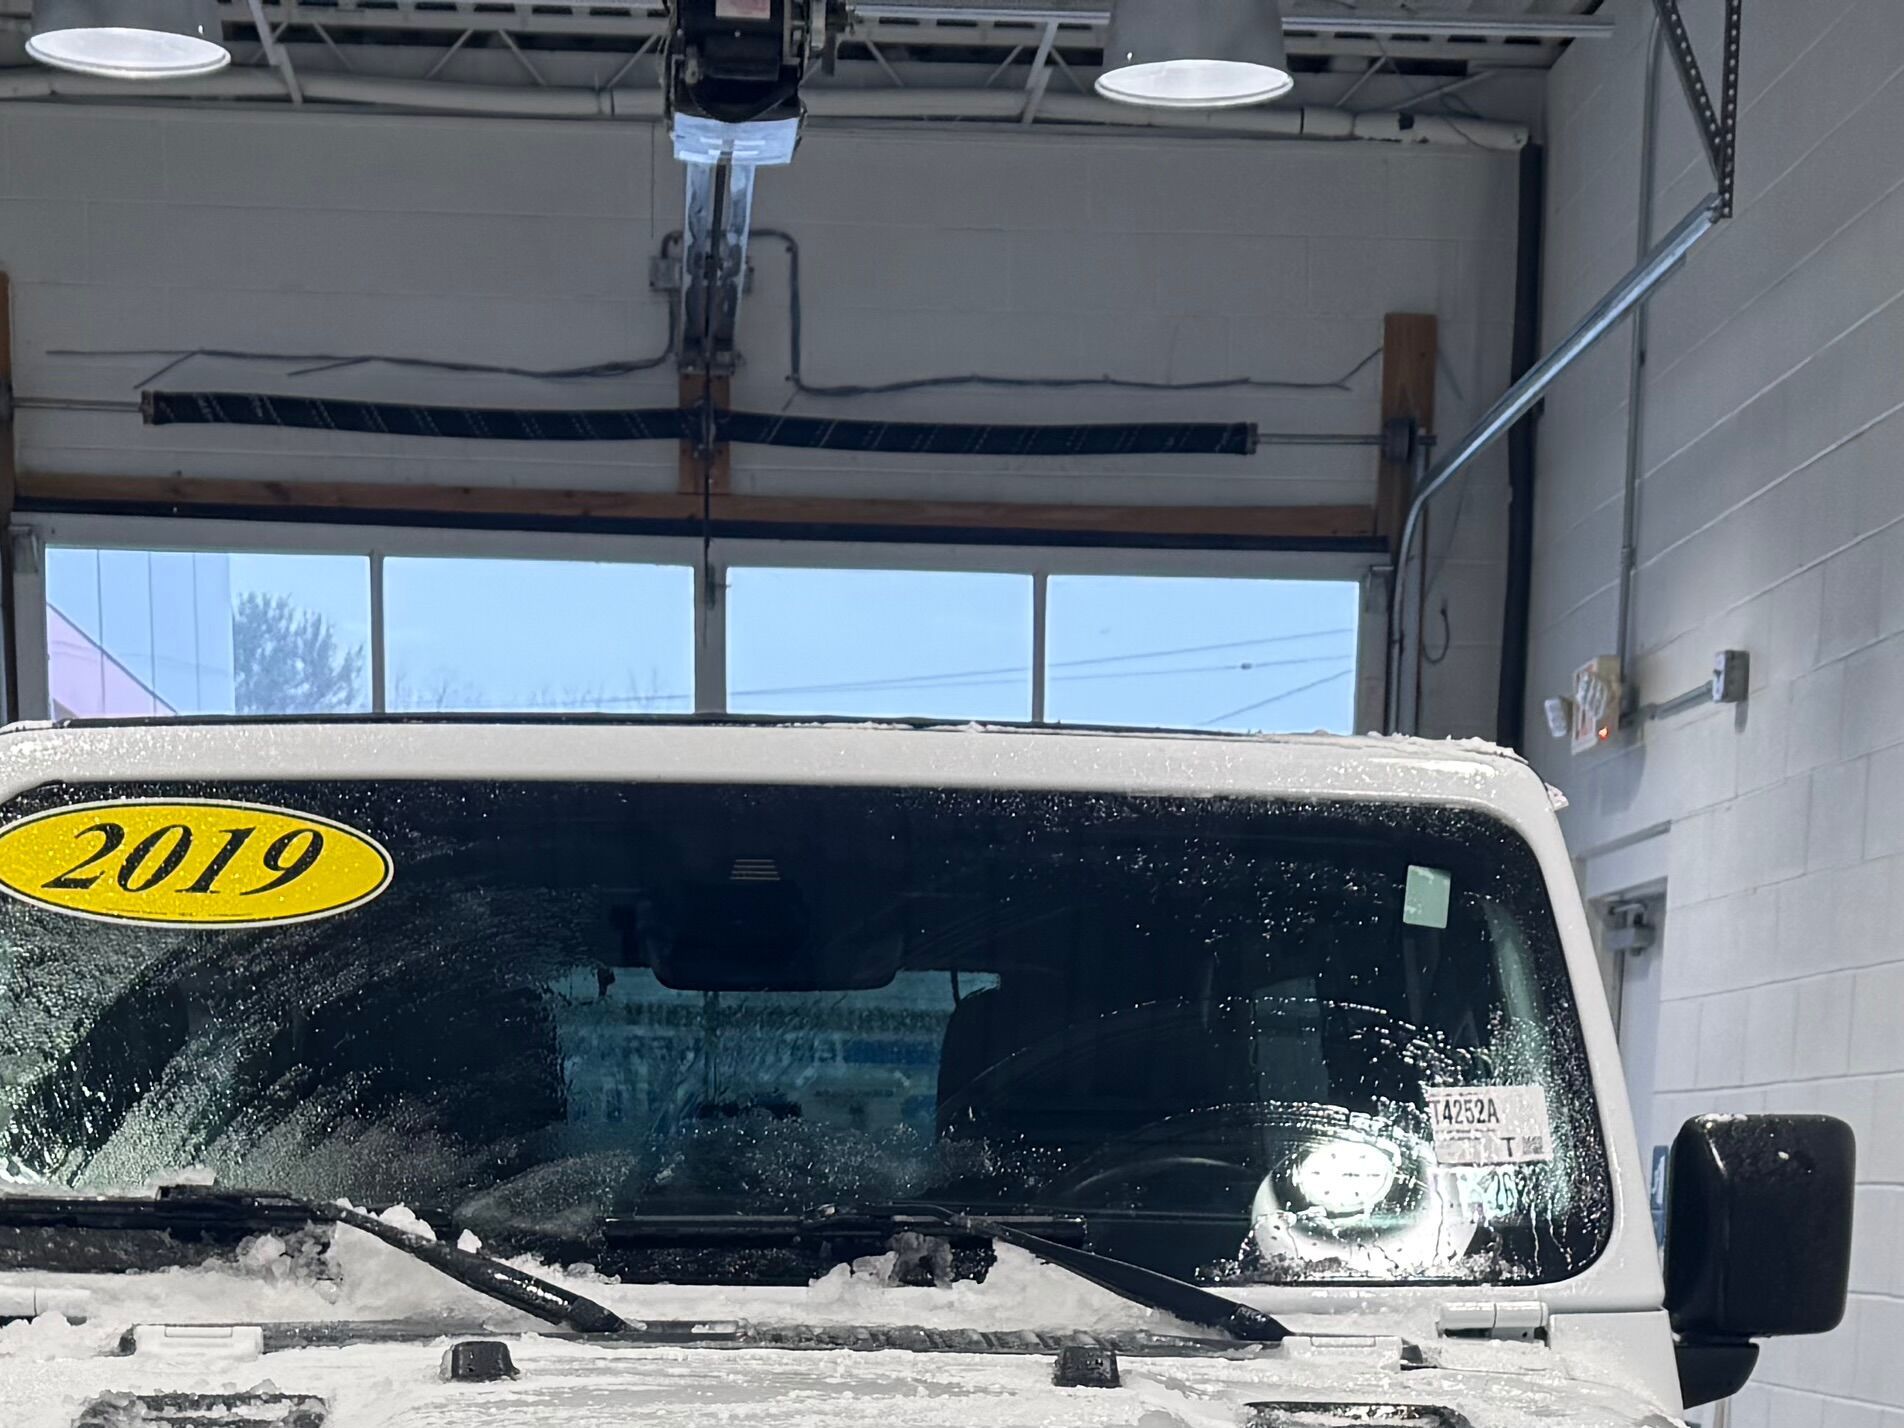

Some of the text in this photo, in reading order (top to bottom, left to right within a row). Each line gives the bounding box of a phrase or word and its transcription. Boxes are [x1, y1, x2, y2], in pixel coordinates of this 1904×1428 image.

[40, 822, 324, 896] 2019
[1429, 1098, 1500, 1126] T4252A
[1500, 1136, 1516, 1158] T
